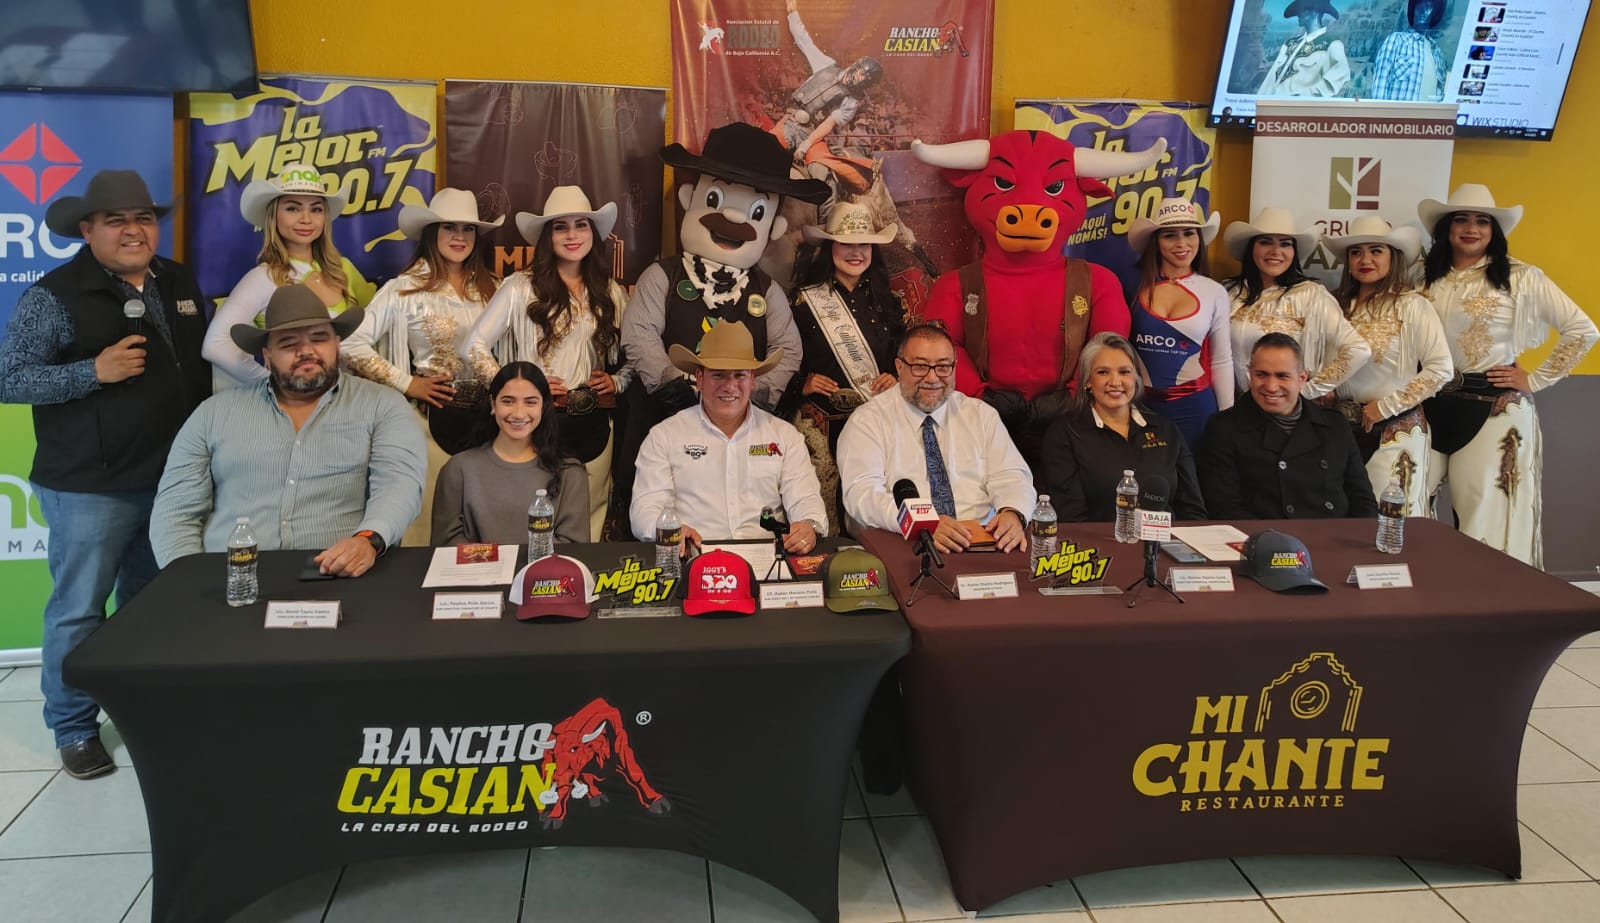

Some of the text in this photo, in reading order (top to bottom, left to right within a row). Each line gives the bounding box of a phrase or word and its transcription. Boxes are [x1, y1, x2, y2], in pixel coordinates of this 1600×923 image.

[727, 24, 780, 49] RODEO
[889, 26, 941, 38] RANCHO
[884, 38, 941, 52] CASIAN
[279, 106, 322, 142] la
[1256, 120, 1455, 136] DESARROLLADOR INMOBILIARIO
[205, 130, 387, 194] Mejor FM
[1161, 167, 1179, 178] FM
[1158, 204, 1187, 217] ARCO
[1136, 333, 1176, 348] ARCO
[1061, 541, 1076, 555] la
[624, 558, 640, 573] la
[1035, 548, 1095, 576] Mejor
[1071, 558, 1108, 585] 90.7
[593, 567, 662, 595] Mejor
[633, 579, 675, 604] 90.7
[1190, 695, 1249, 734] MI
[358, 722, 554, 766] RANCHO
[1132, 738, 1390, 797] CHANTE
[337, 763, 557, 816] CASIAN
[1179, 795, 1345, 812] RESTAURANTE
[341, 820, 529, 834] LA CASA DEL RODEO
